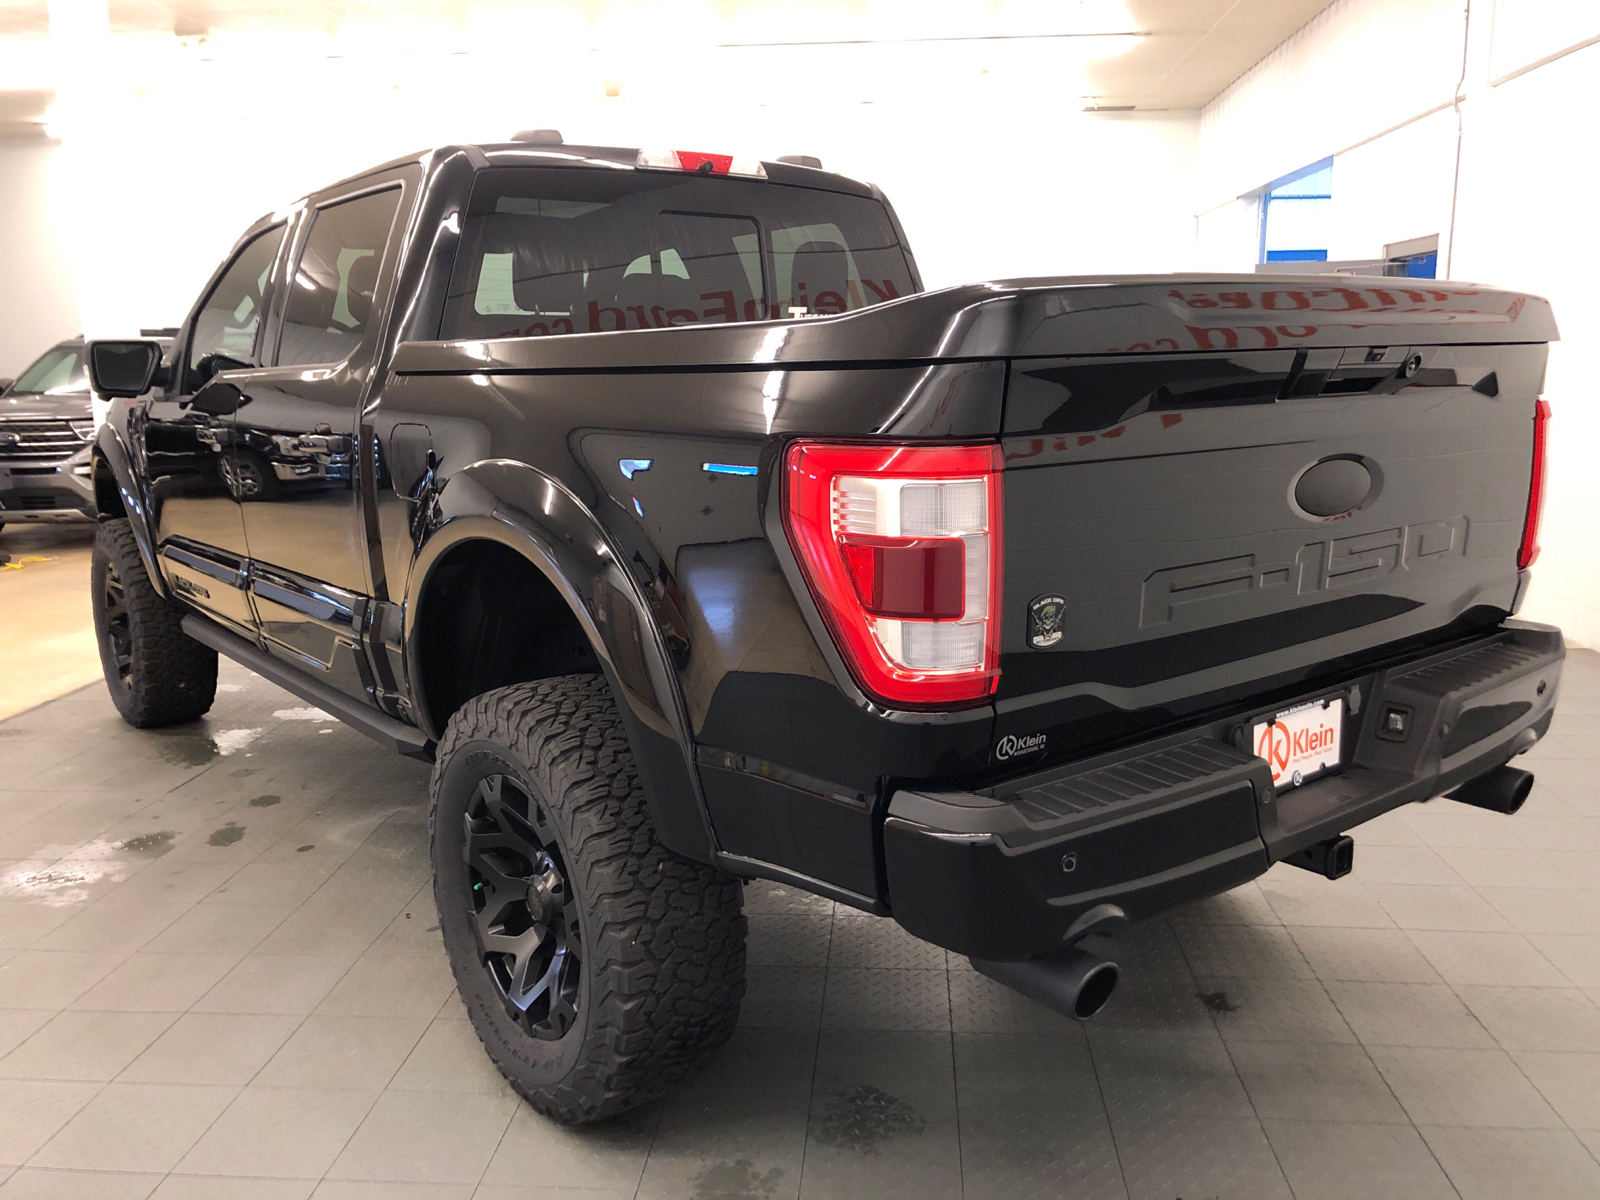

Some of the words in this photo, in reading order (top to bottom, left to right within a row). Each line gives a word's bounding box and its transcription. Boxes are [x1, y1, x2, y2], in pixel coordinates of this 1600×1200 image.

[1139, 515, 1469, 628] F-150
[1017, 733, 1047, 749] Klein
[1293, 723, 1334, 757] Klein
